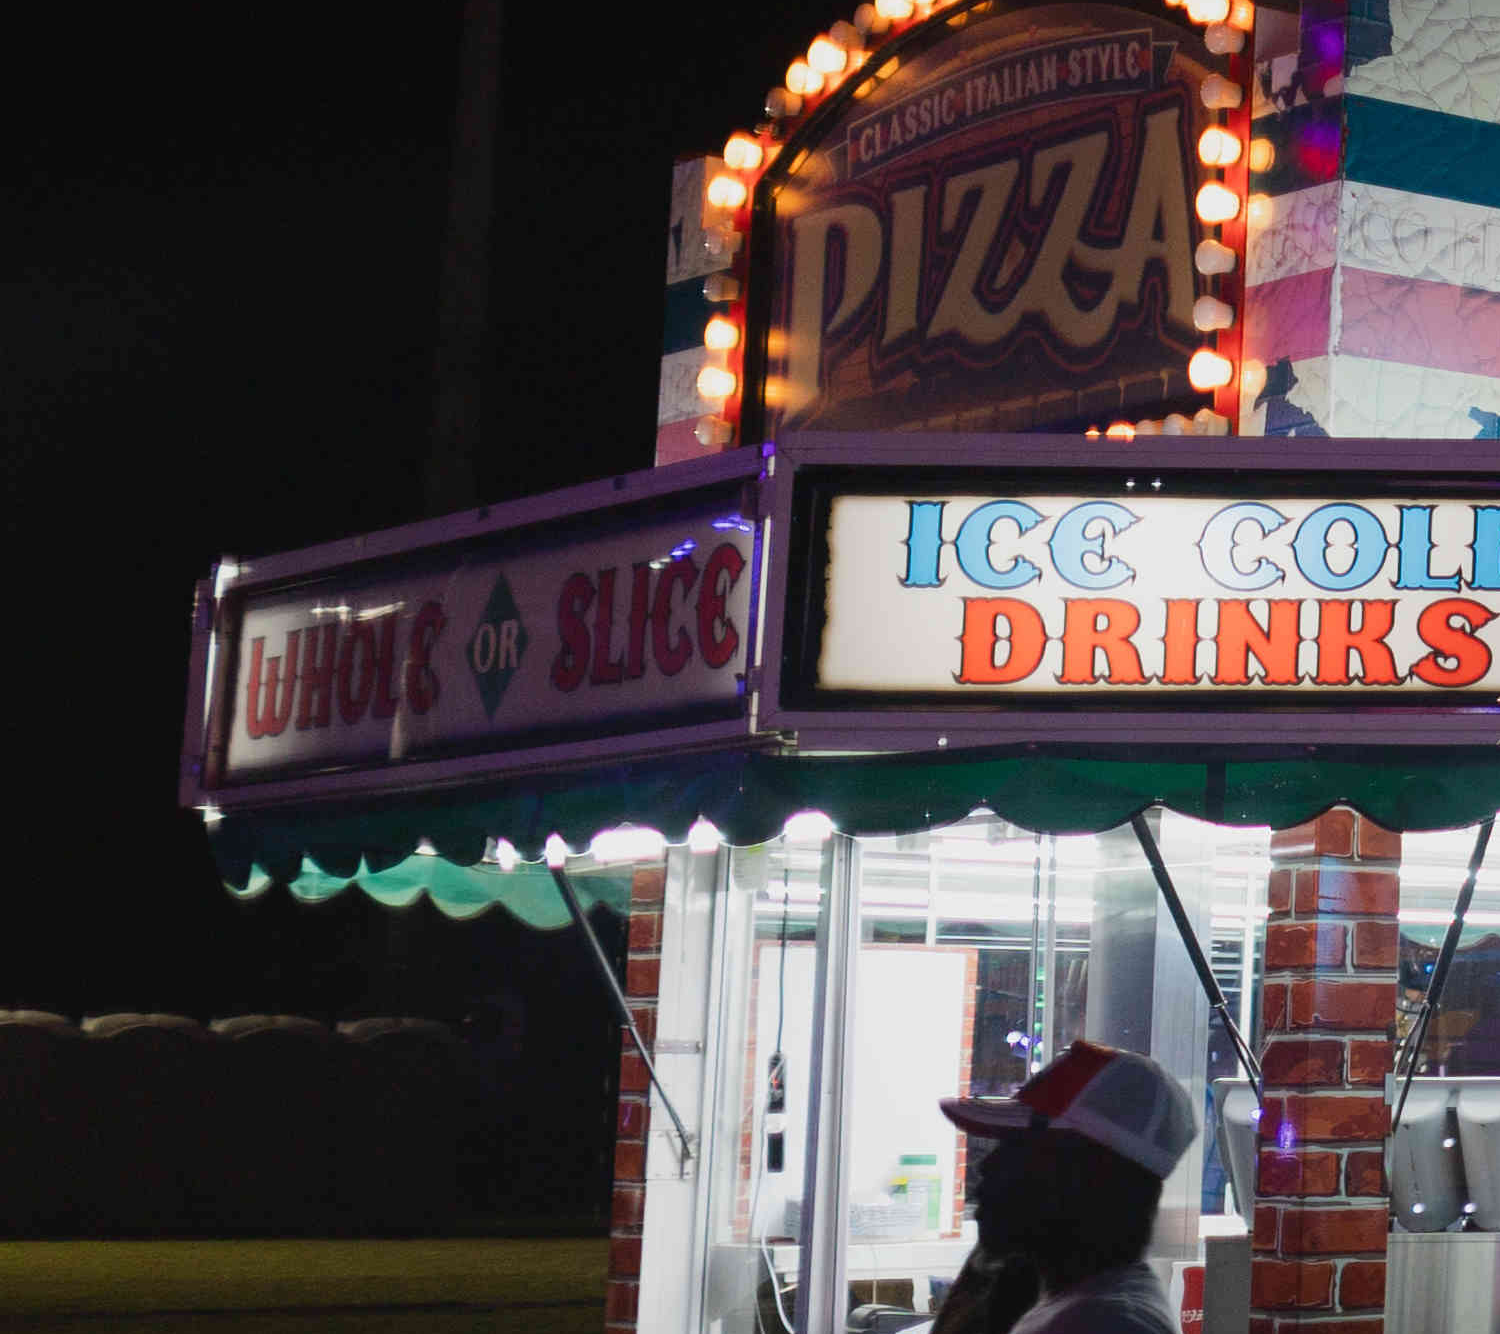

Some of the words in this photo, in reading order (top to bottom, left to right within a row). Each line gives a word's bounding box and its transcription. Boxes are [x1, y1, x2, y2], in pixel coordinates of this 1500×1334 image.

[859, 90, 955, 164] CLASSIC
[965, 55, 1058, 117] ITALIAN
[1067, 41, 1142, 89] STYLE
[782, 107, 1198, 430] PIZZA
[898, 499, 1143, 590] ICE
[246, 601, 447, 740] WHOLE
[473, 619, 519, 674] OR
[550, 542, 747, 693] SLICE
[952, 596, 1500, 687] DRINKS
